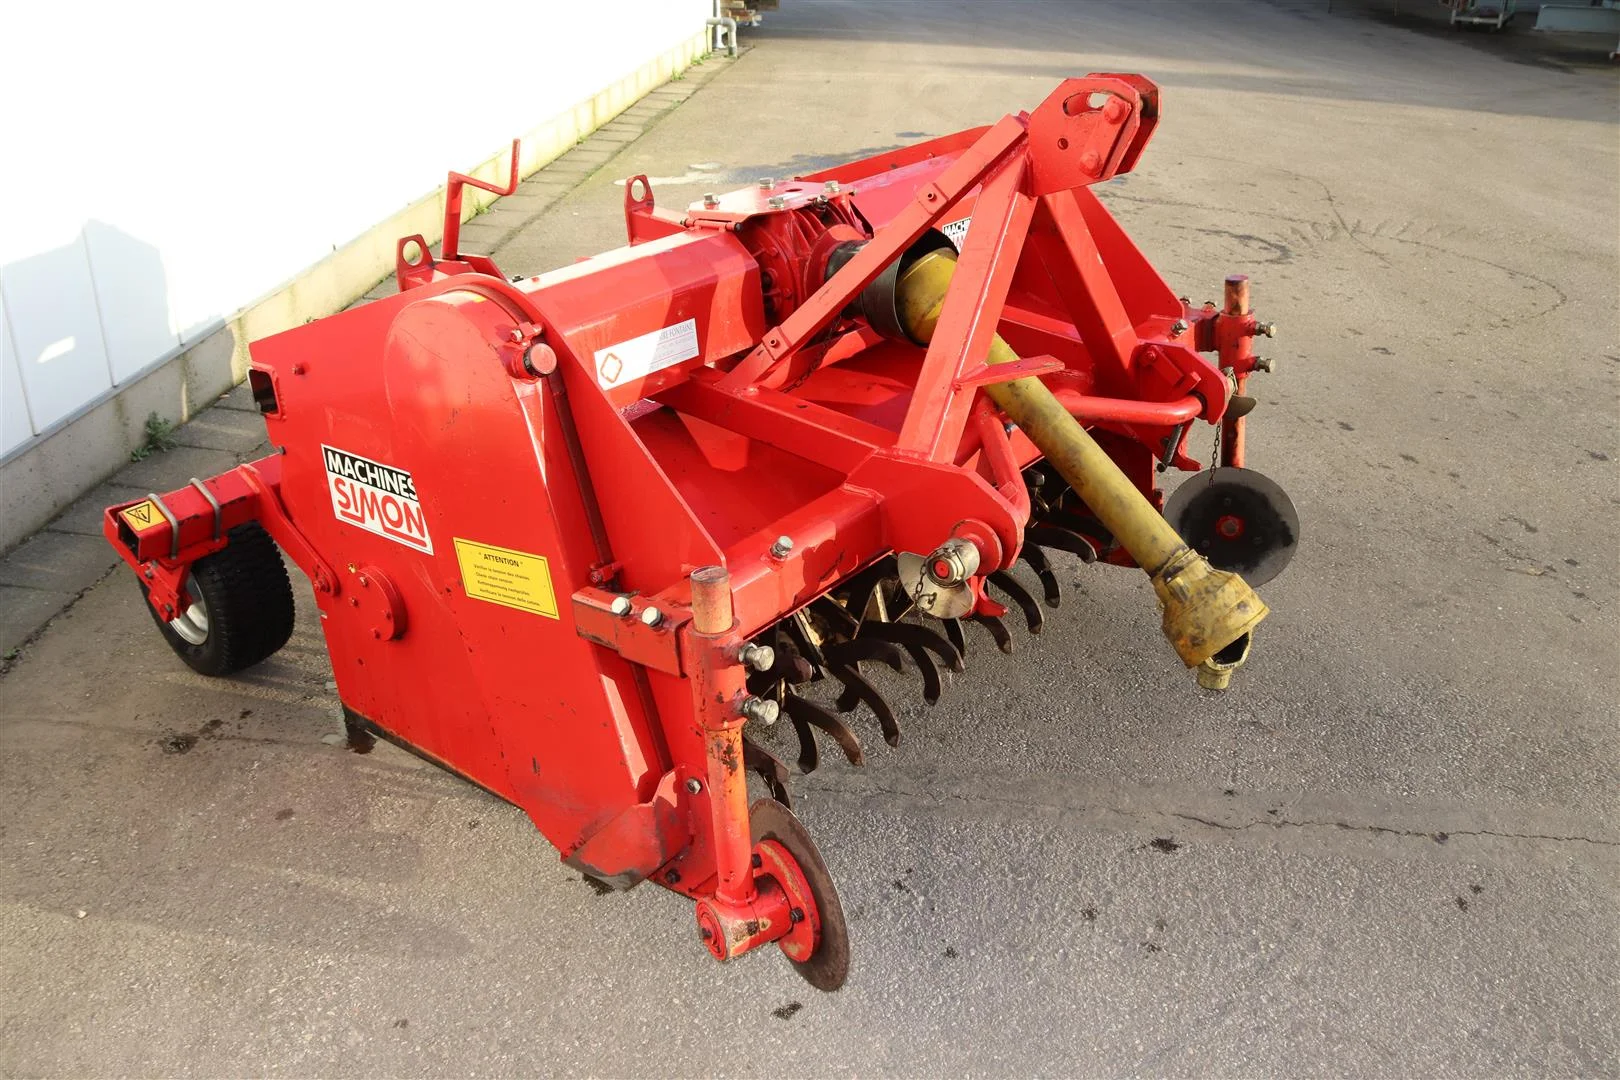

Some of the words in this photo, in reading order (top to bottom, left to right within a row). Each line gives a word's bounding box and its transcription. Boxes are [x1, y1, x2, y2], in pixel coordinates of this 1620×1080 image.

[327, 450, 418, 500] MACHINES
[334, 477, 427, 547] SIMON
[483, 553, 520, 567] ATTENTION
